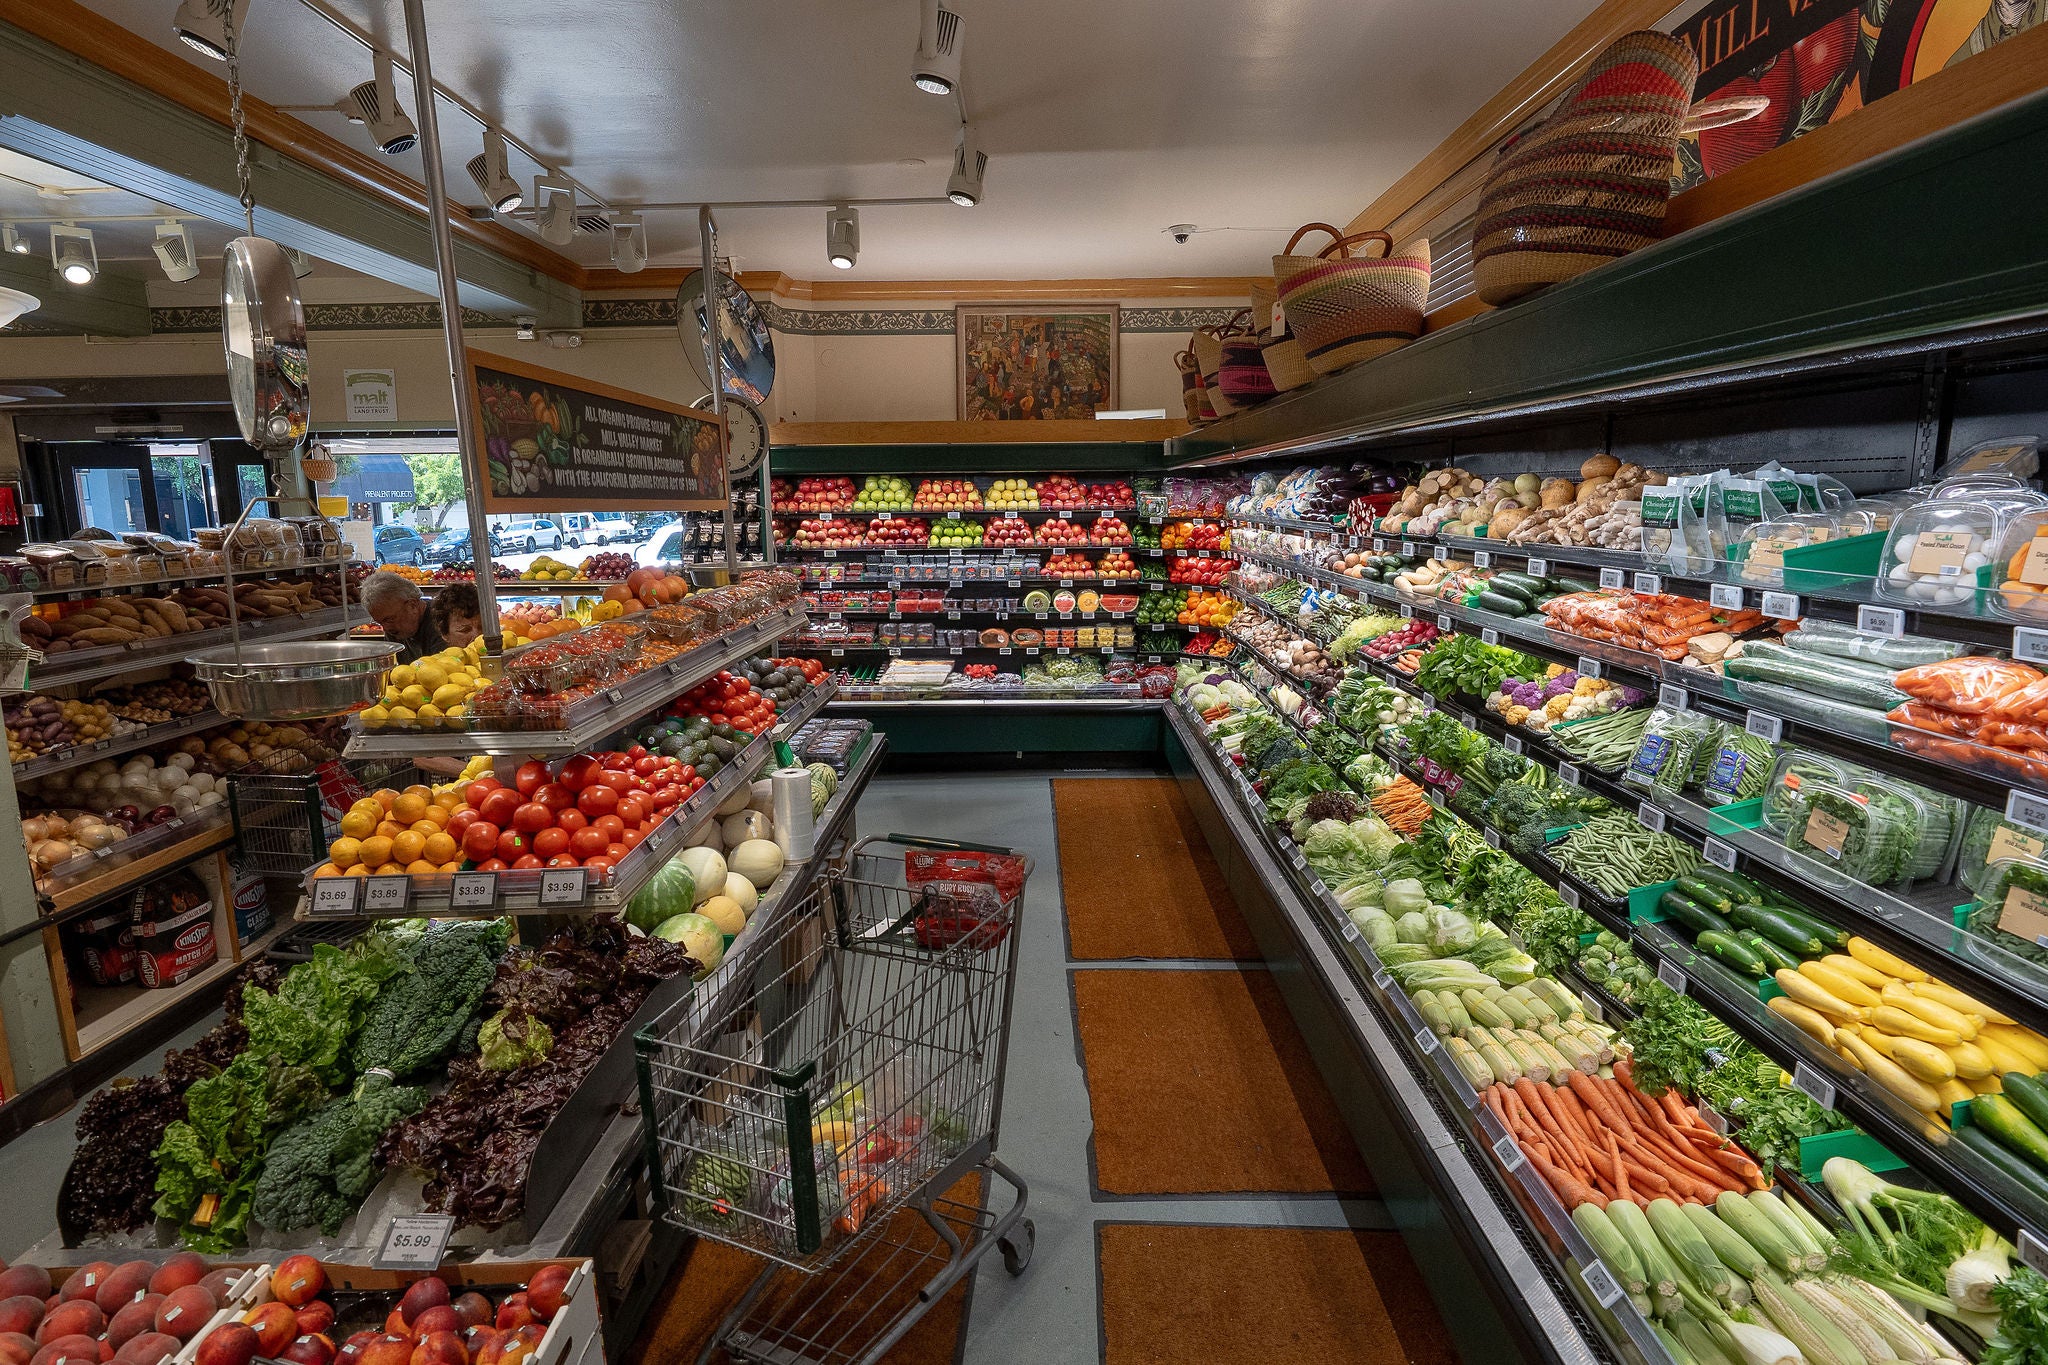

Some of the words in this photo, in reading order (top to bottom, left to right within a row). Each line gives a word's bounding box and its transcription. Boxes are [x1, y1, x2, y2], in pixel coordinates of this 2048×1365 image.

[1681, 0, 1770, 76] MILL
[353, 389, 388, 403] malt
[585, 405, 598, 422] ALL
[598, 408, 626, 428] ORGANIC
[626, 414, 650, 432] PRODUCE
[651, 420, 664, 435] SOLD
[664, 422, 671, 437] BY
[749, 424, 755, 433] 2
[601, 429, 618, 447] MILL
[618, 432, 639, 449] VALLEY
[640, 436, 663, 453] MARKET
[750, 441, 756, 450] 3
[573, 446, 581, 464] IS
[581, 448, 625, 468] ORGANICALLY
[625, 453, 646, 470] GROWN
[646, 455, 654, 471] IN
[740, 454, 746, 462] 4
[554, 468, 576, 488] WITH
[576, 469, 591, 487] THE
[591, 471, 629, 489] CALIFORNIA
[629, 473, 653, 489] ORGANIC
[678, 477, 685, 490] OF
[365, 490, 390, 498] PREVALENT
[391, 490, 413, 498] PROJECTS
[2024, 807, 2046, 821] $2.29
[371, 889, 398, 899] $3.89
[458, 886, 486, 896] $3.89
[547, 882, 575, 893] $3.99
[939, 882, 957, 893] RUBY
[957, 884, 976, 895] RUSH
[320, 891, 347, 901] $3.69
[176, 950, 201, 966] MATCH
[393, 1233, 431, 1249] $5.99
